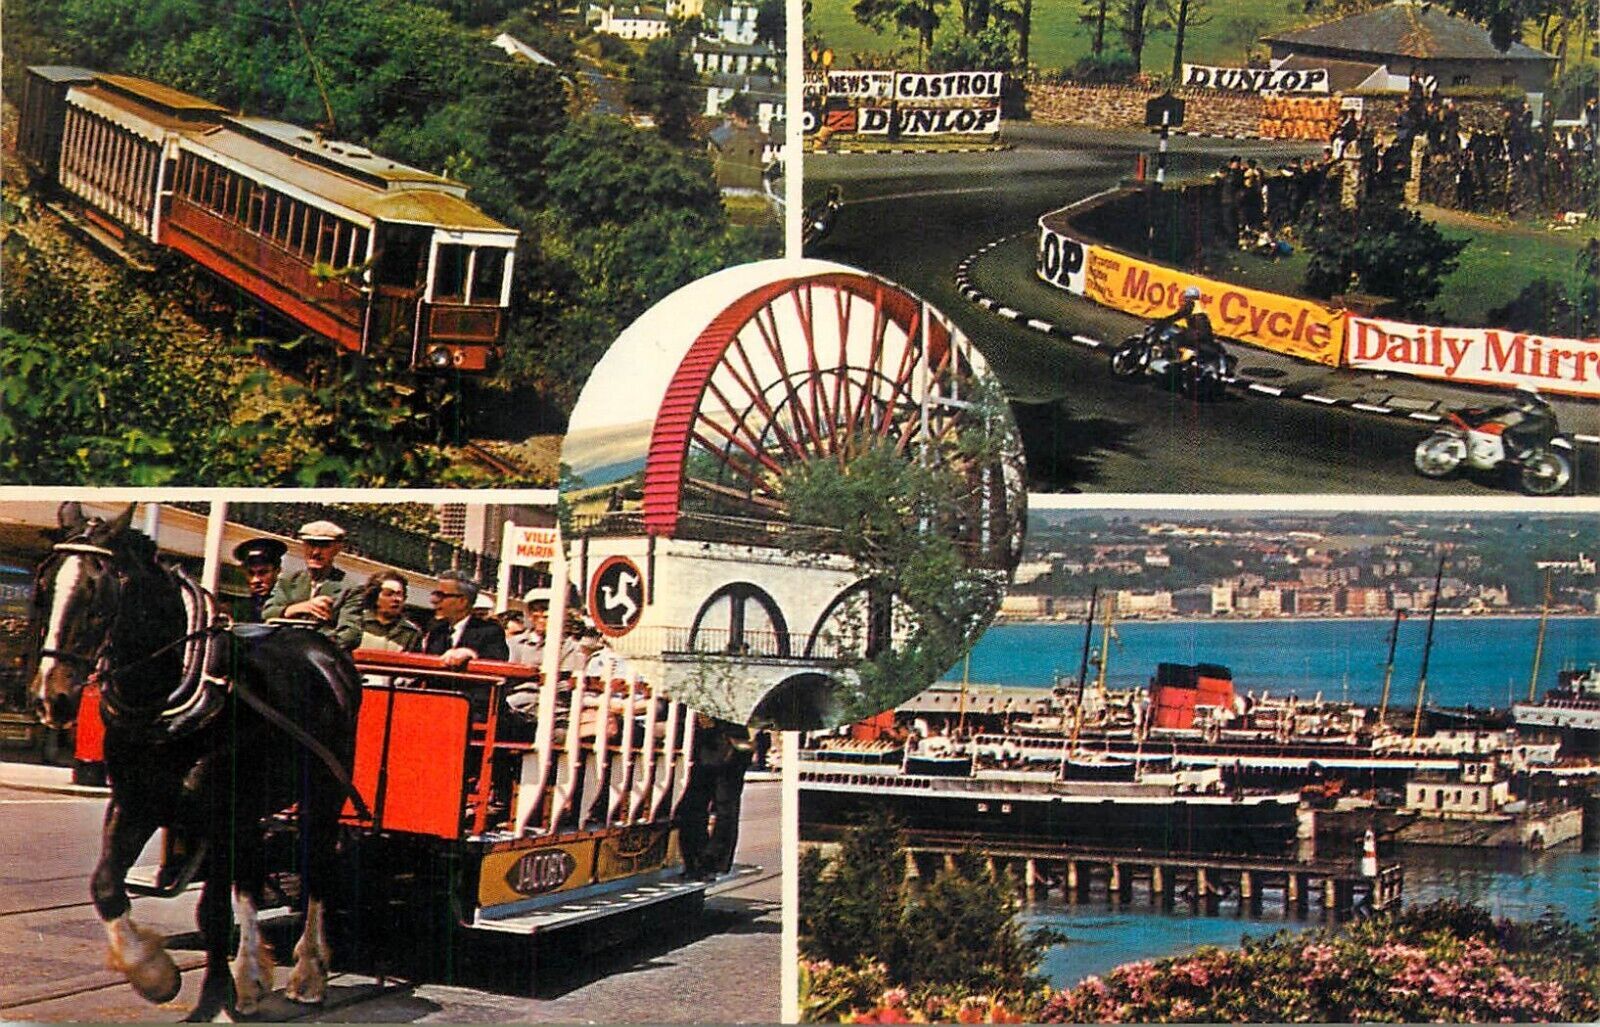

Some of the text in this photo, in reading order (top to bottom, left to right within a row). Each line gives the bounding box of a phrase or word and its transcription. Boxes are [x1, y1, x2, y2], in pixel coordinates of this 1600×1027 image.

[828, 75, 870, 93] NEWS
[899, 74, 998, 97] CASTROL
[1186, 66, 1325, 91] DUNLOP
[861, 110, 997, 132] DUNLOP
[1219, 291, 1331, 348] Cycle
[1354, 321, 1474, 376] Daily
